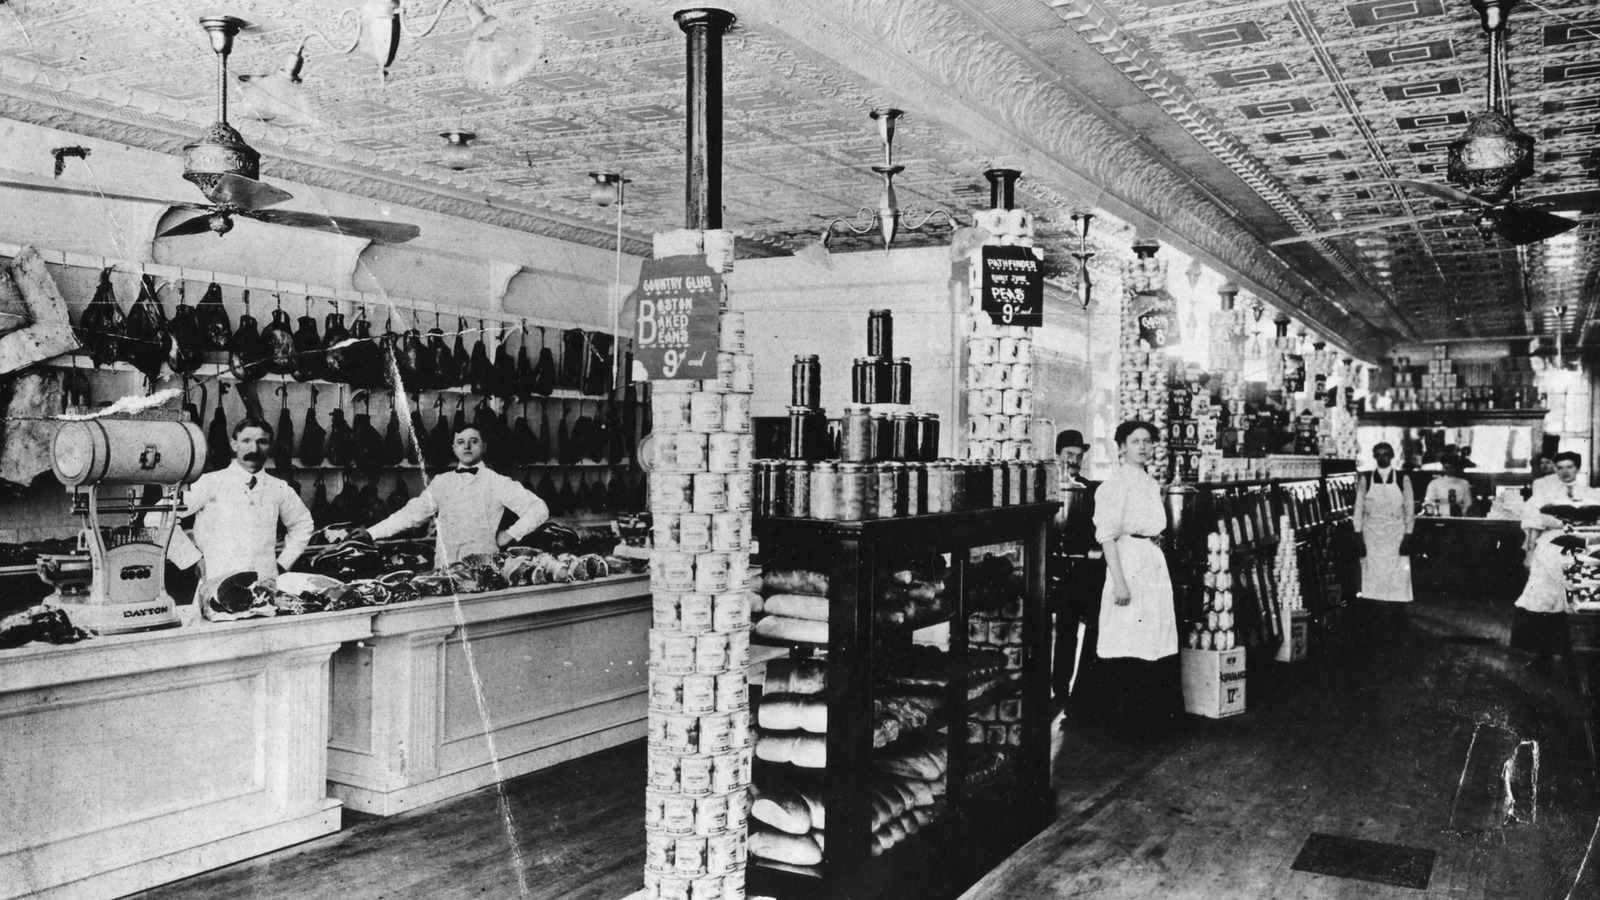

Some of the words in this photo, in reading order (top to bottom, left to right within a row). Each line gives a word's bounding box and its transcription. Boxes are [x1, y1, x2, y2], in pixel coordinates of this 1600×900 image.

[986, 258, 1037, 270] PATHFINDER
[643, 276, 683, 292] COUNTRY
[685, 275, 713, 289] CLUB
[991, 287, 1025, 300] PEAS
[123, 606, 168, 618] DAYTON
